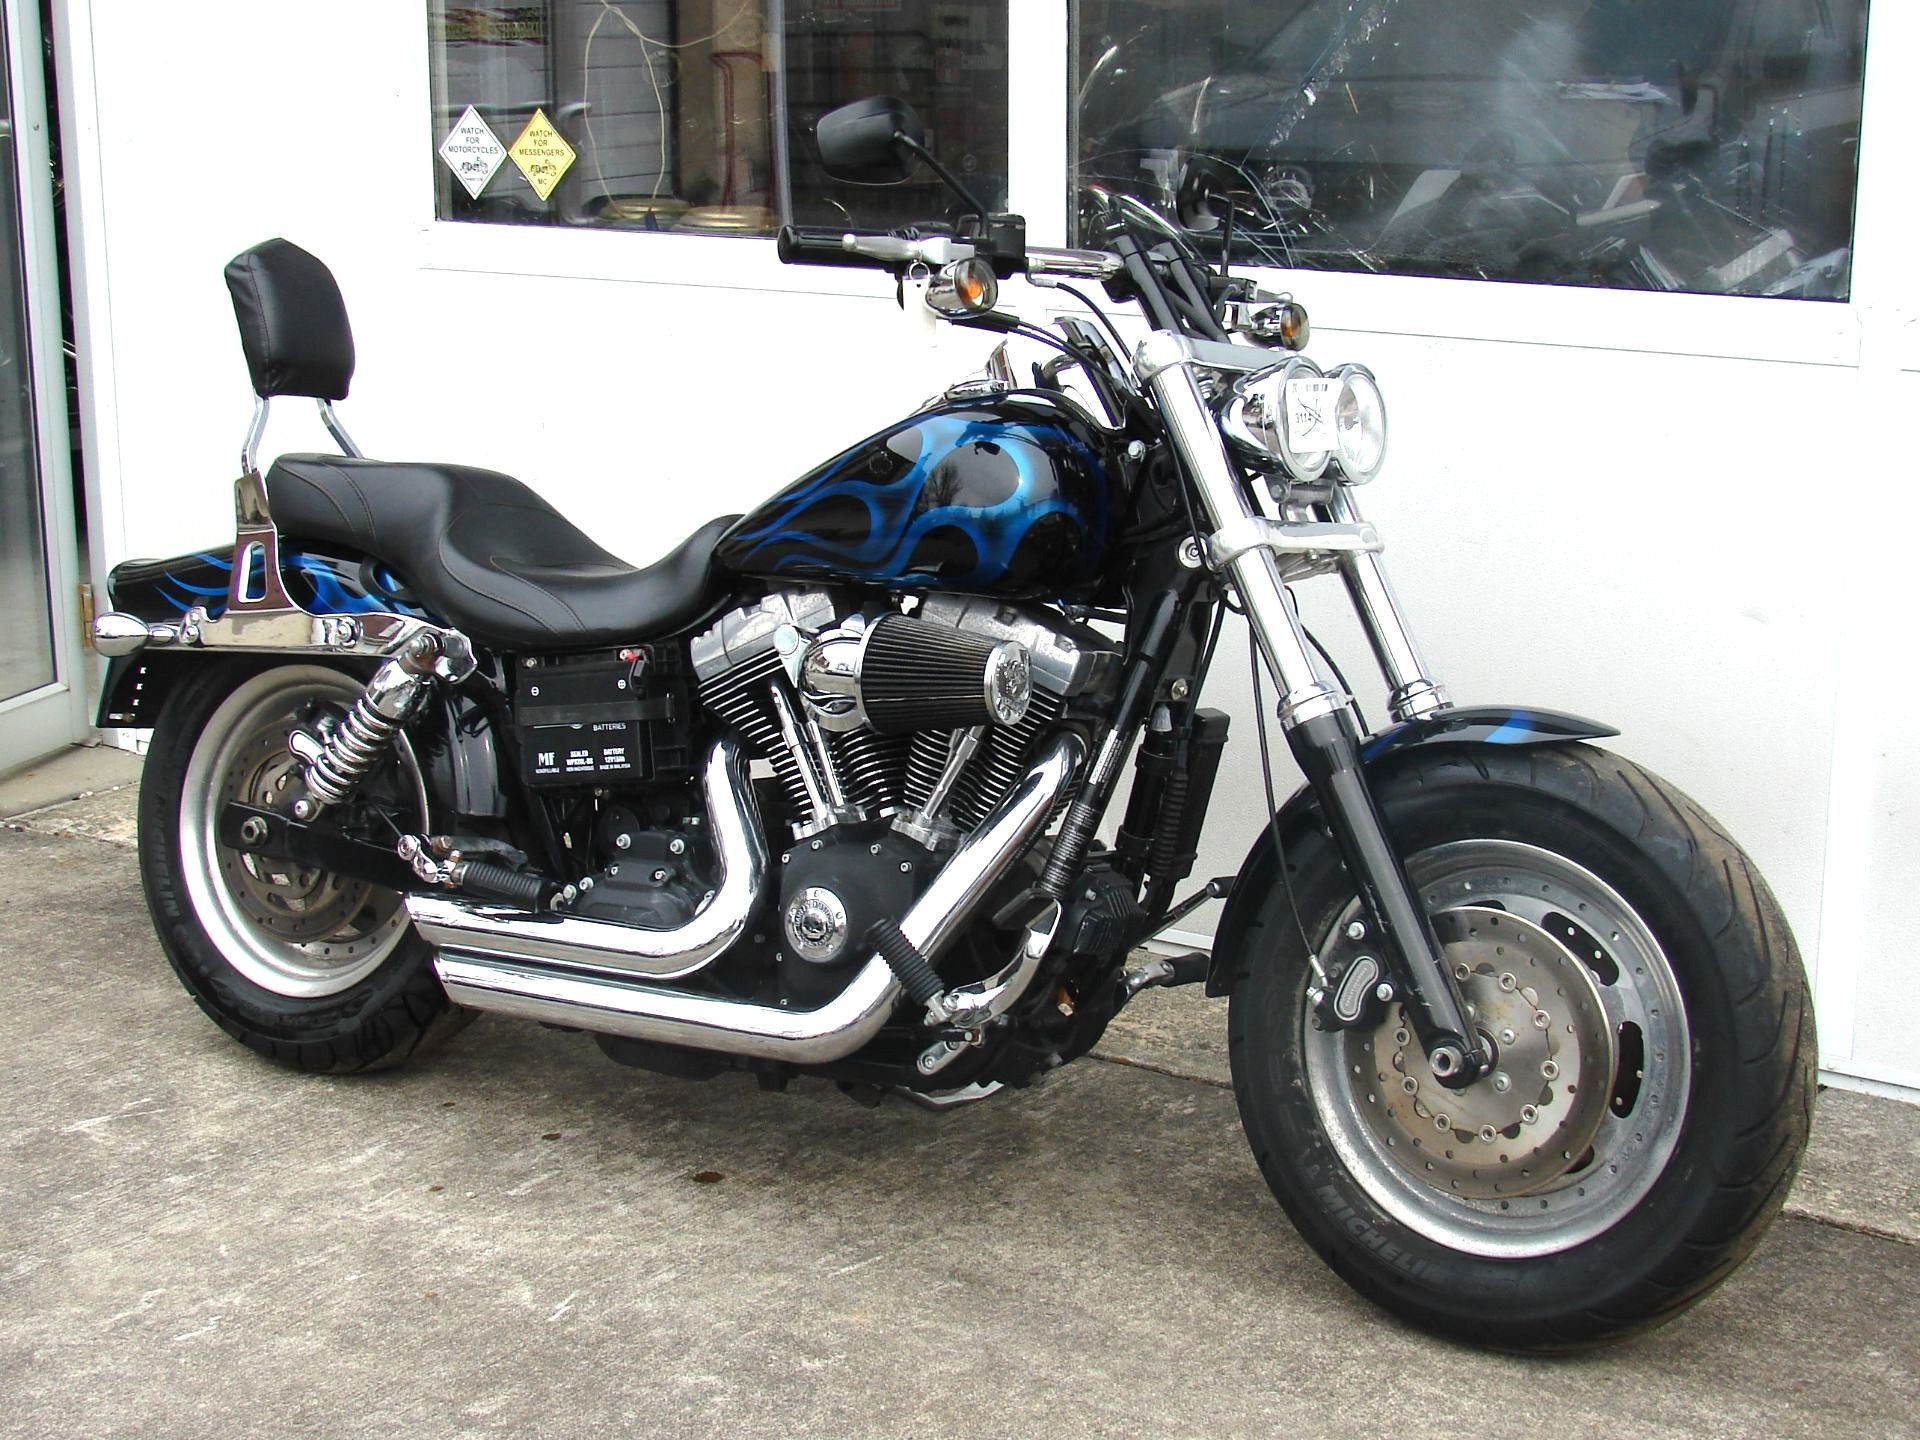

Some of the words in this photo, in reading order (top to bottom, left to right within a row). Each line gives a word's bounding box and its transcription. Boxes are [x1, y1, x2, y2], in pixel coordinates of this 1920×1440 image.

[460, 127, 485, 135] WATCH
[529, 129, 553, 138] WATCH
[465, 136, 480, 145] FOR
[533, 139, 548, 147] FOR
[448, 145, 499, 154] MOTORCYCLES
[519, 148, 565, 157] MESSENGERS
[592, 722, 627, 732] BATTERIES
[538, 752, 555, 767] MF
